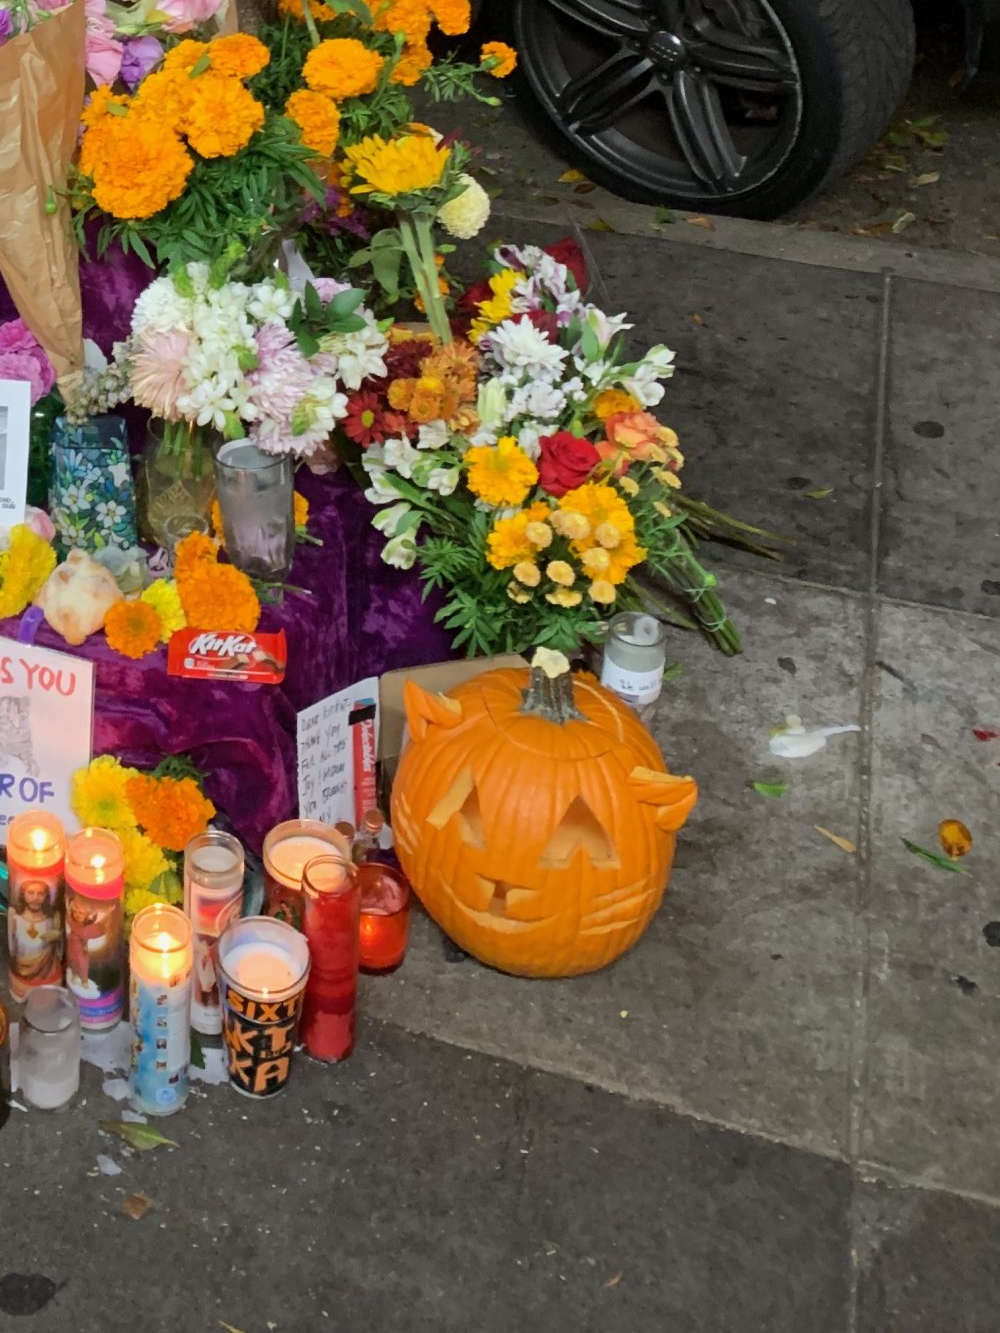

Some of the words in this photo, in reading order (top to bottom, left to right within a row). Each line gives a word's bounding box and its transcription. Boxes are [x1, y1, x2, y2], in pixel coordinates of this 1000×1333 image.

[189, 633, 257, 657] KitKat
[19, 658, 77, 697] YOU
[19, 777, 56, 804] OF
[228, 989, 299, 1023] SIXT
